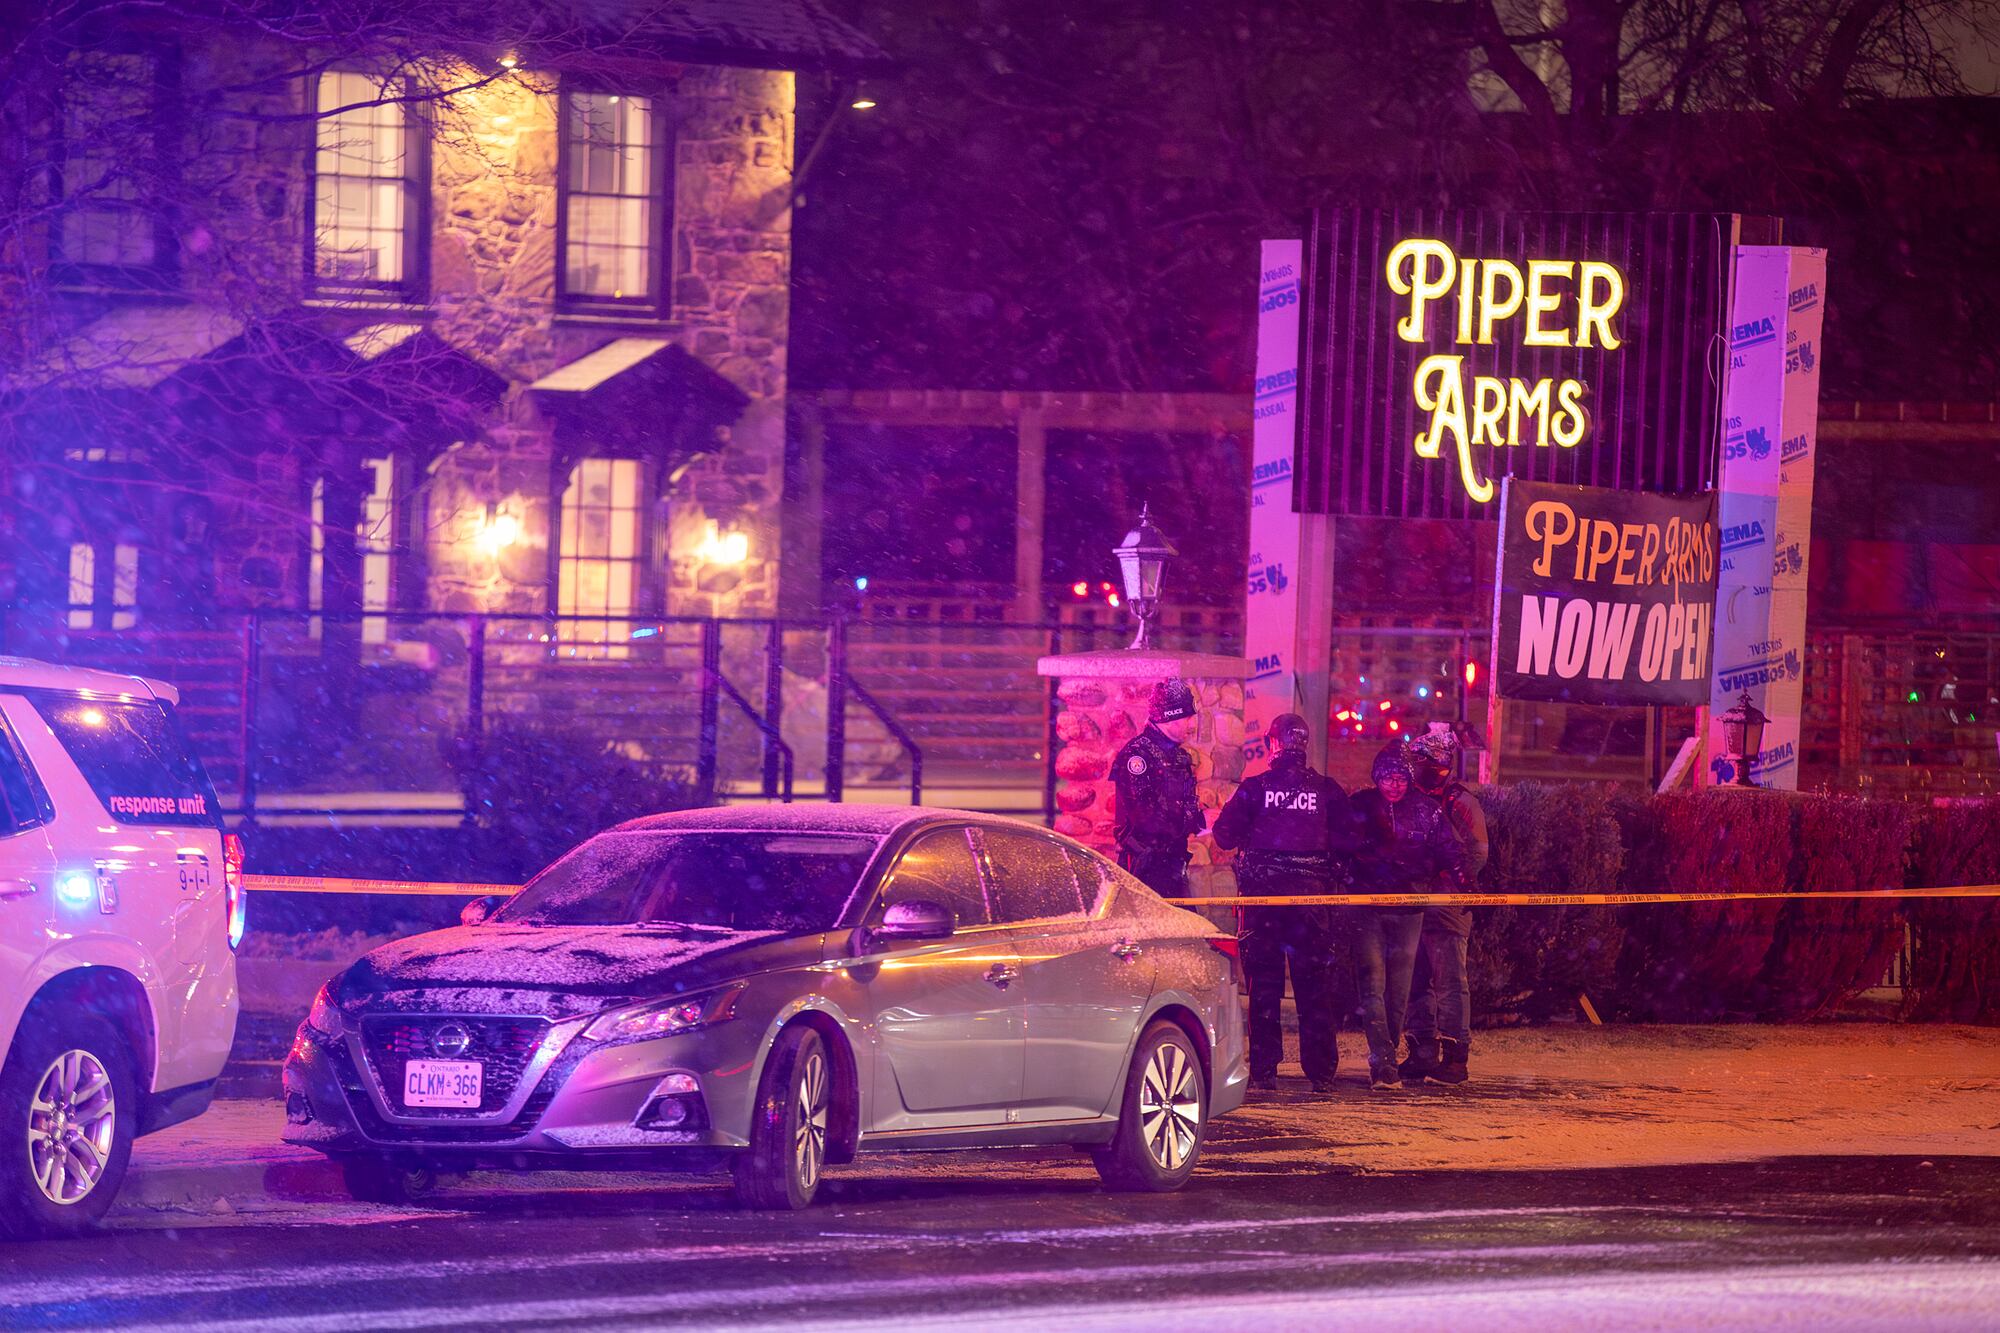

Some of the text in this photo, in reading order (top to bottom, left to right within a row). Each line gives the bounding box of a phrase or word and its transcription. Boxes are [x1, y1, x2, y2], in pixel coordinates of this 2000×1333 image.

[1386, 238, 1624, 350] PIPER
[1413, 354, 1585, 503] ARMS
[1781, 434, 1807, 457] EMA
[1252, 458, 1291, 480] EMA
[1525, 500, 1713, 605] PIPER ARMS
[1516, 594, 1711, 682] NOW OPEN
[1163, 708, 1183, 718] POLICE
[110, 793, 206, 817] response unit
